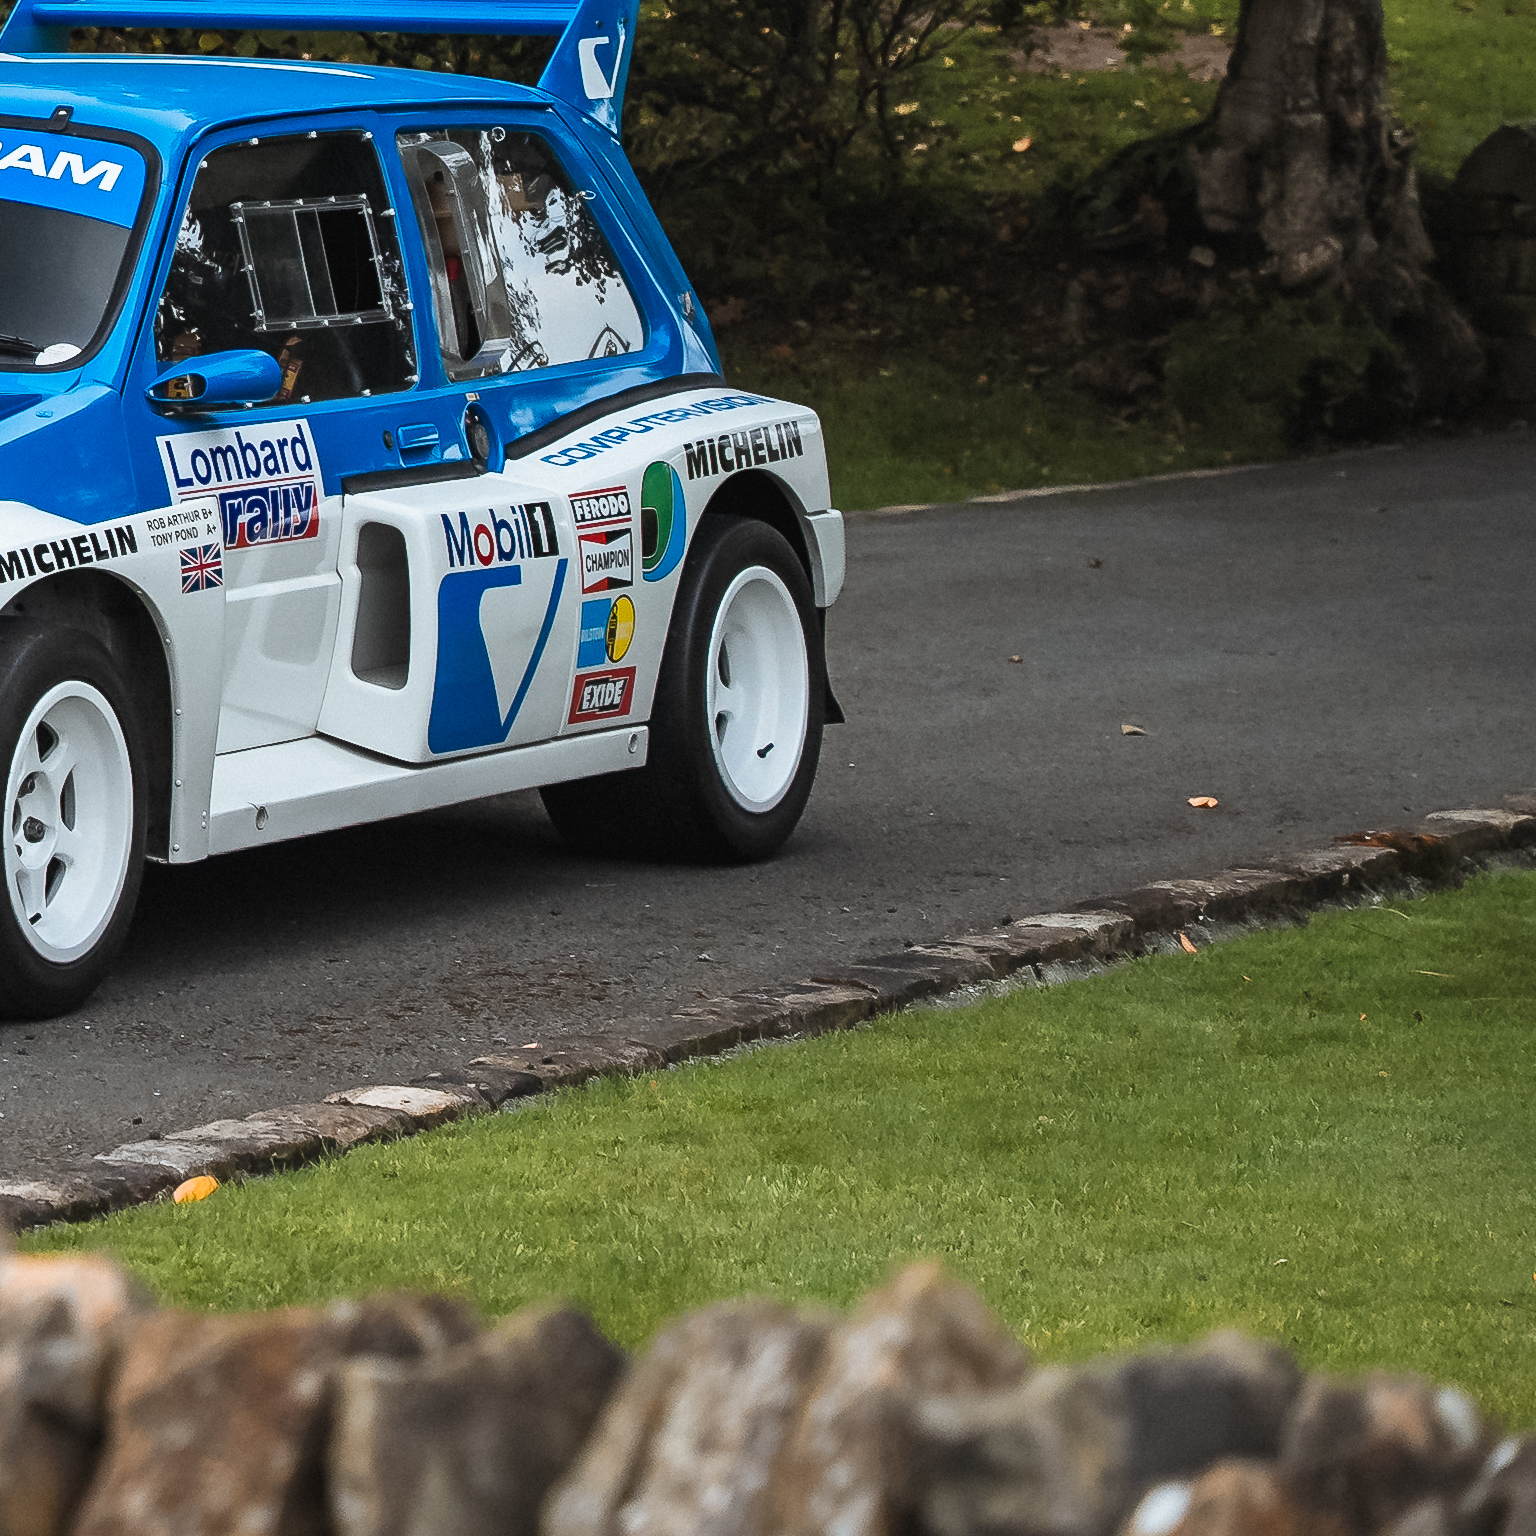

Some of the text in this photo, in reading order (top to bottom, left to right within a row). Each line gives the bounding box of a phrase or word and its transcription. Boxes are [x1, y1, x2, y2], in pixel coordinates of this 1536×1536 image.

[539, 394, 778, 467] COMPUTERVISION
[682, 420, 804, 481] MICHELIN
[165, 424, 313, 488] Lombard
[146, 507, 214, 532] ROB ARTHUR B+
[225, 483, 315, 547] rally
[573, 494, 630, 524] FERODO
[150, 524, 217, 547] TONY POND A+
[440, 504, 533, 568] Mobil
[585, 549, 630, 574] CHAMPION
[582, 679, 624, 709] EXIDE
